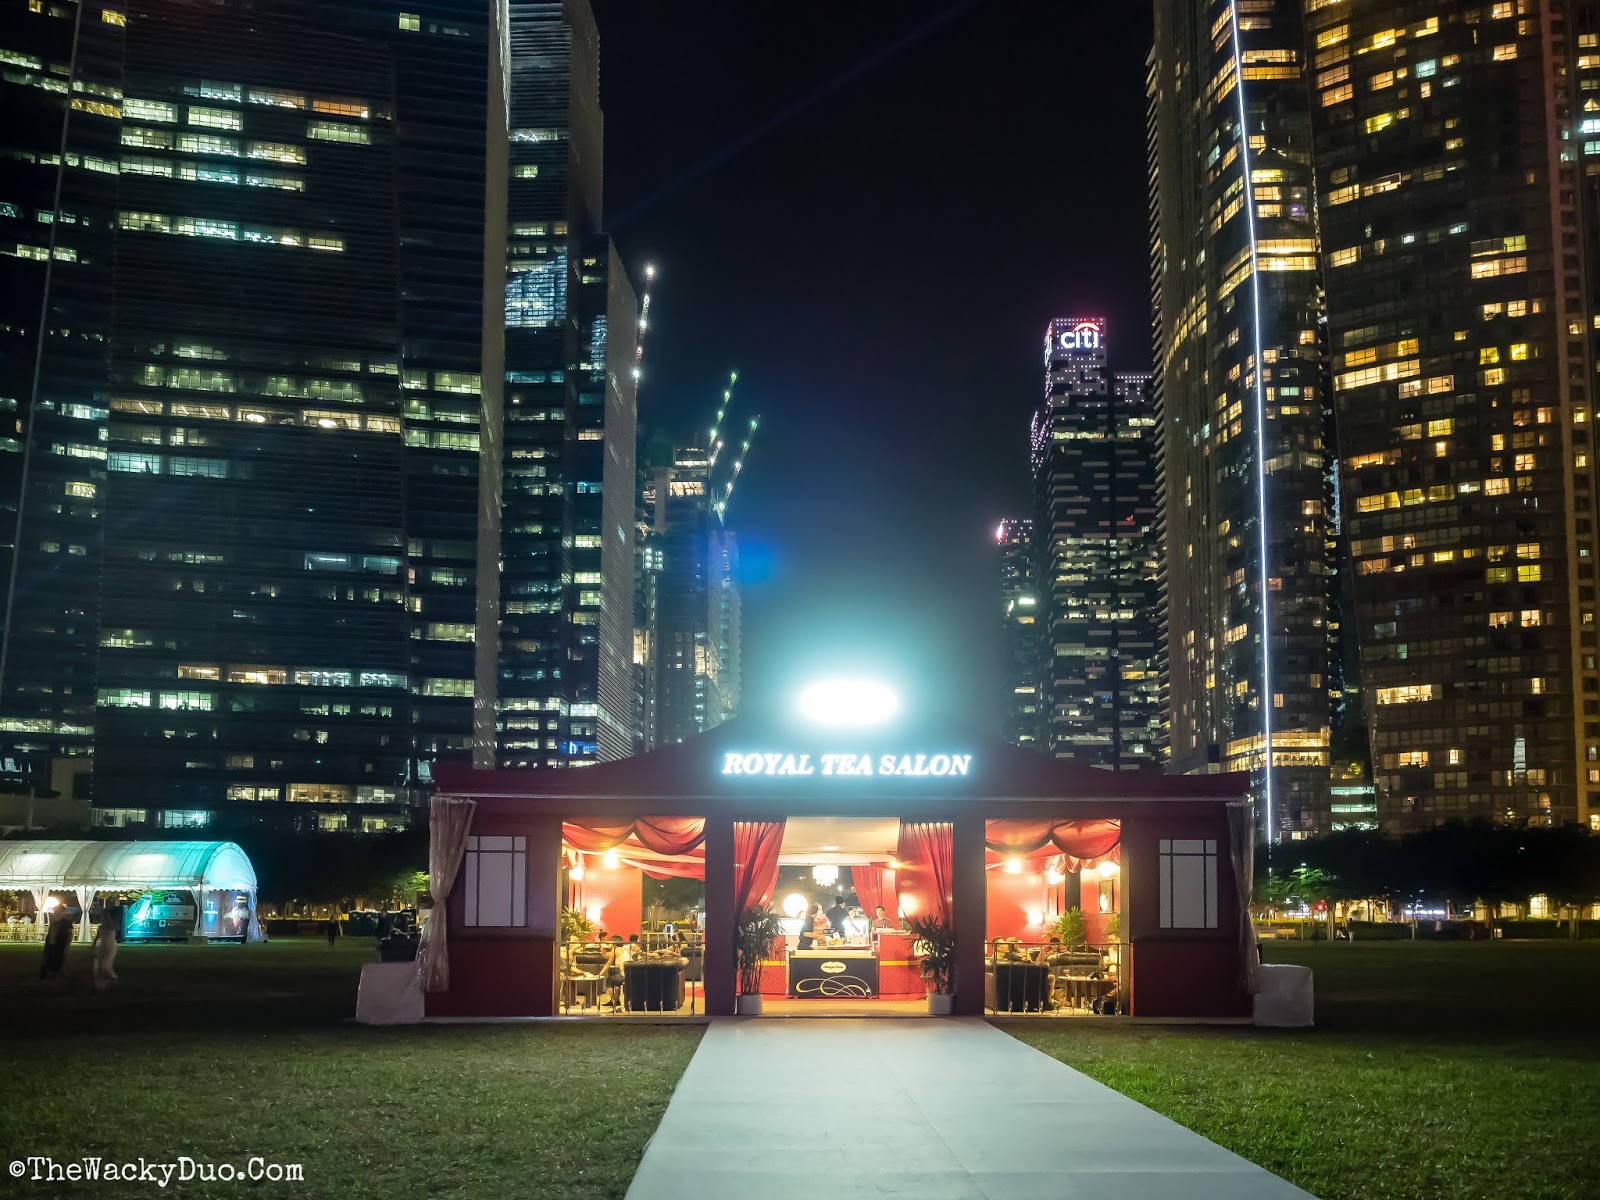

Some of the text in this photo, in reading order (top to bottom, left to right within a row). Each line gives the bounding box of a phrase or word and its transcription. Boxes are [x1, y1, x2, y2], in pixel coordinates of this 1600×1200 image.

[1060, 323, 1099, 348] citi
[722, 753, 971, 775] ROYAL TEA SALON
